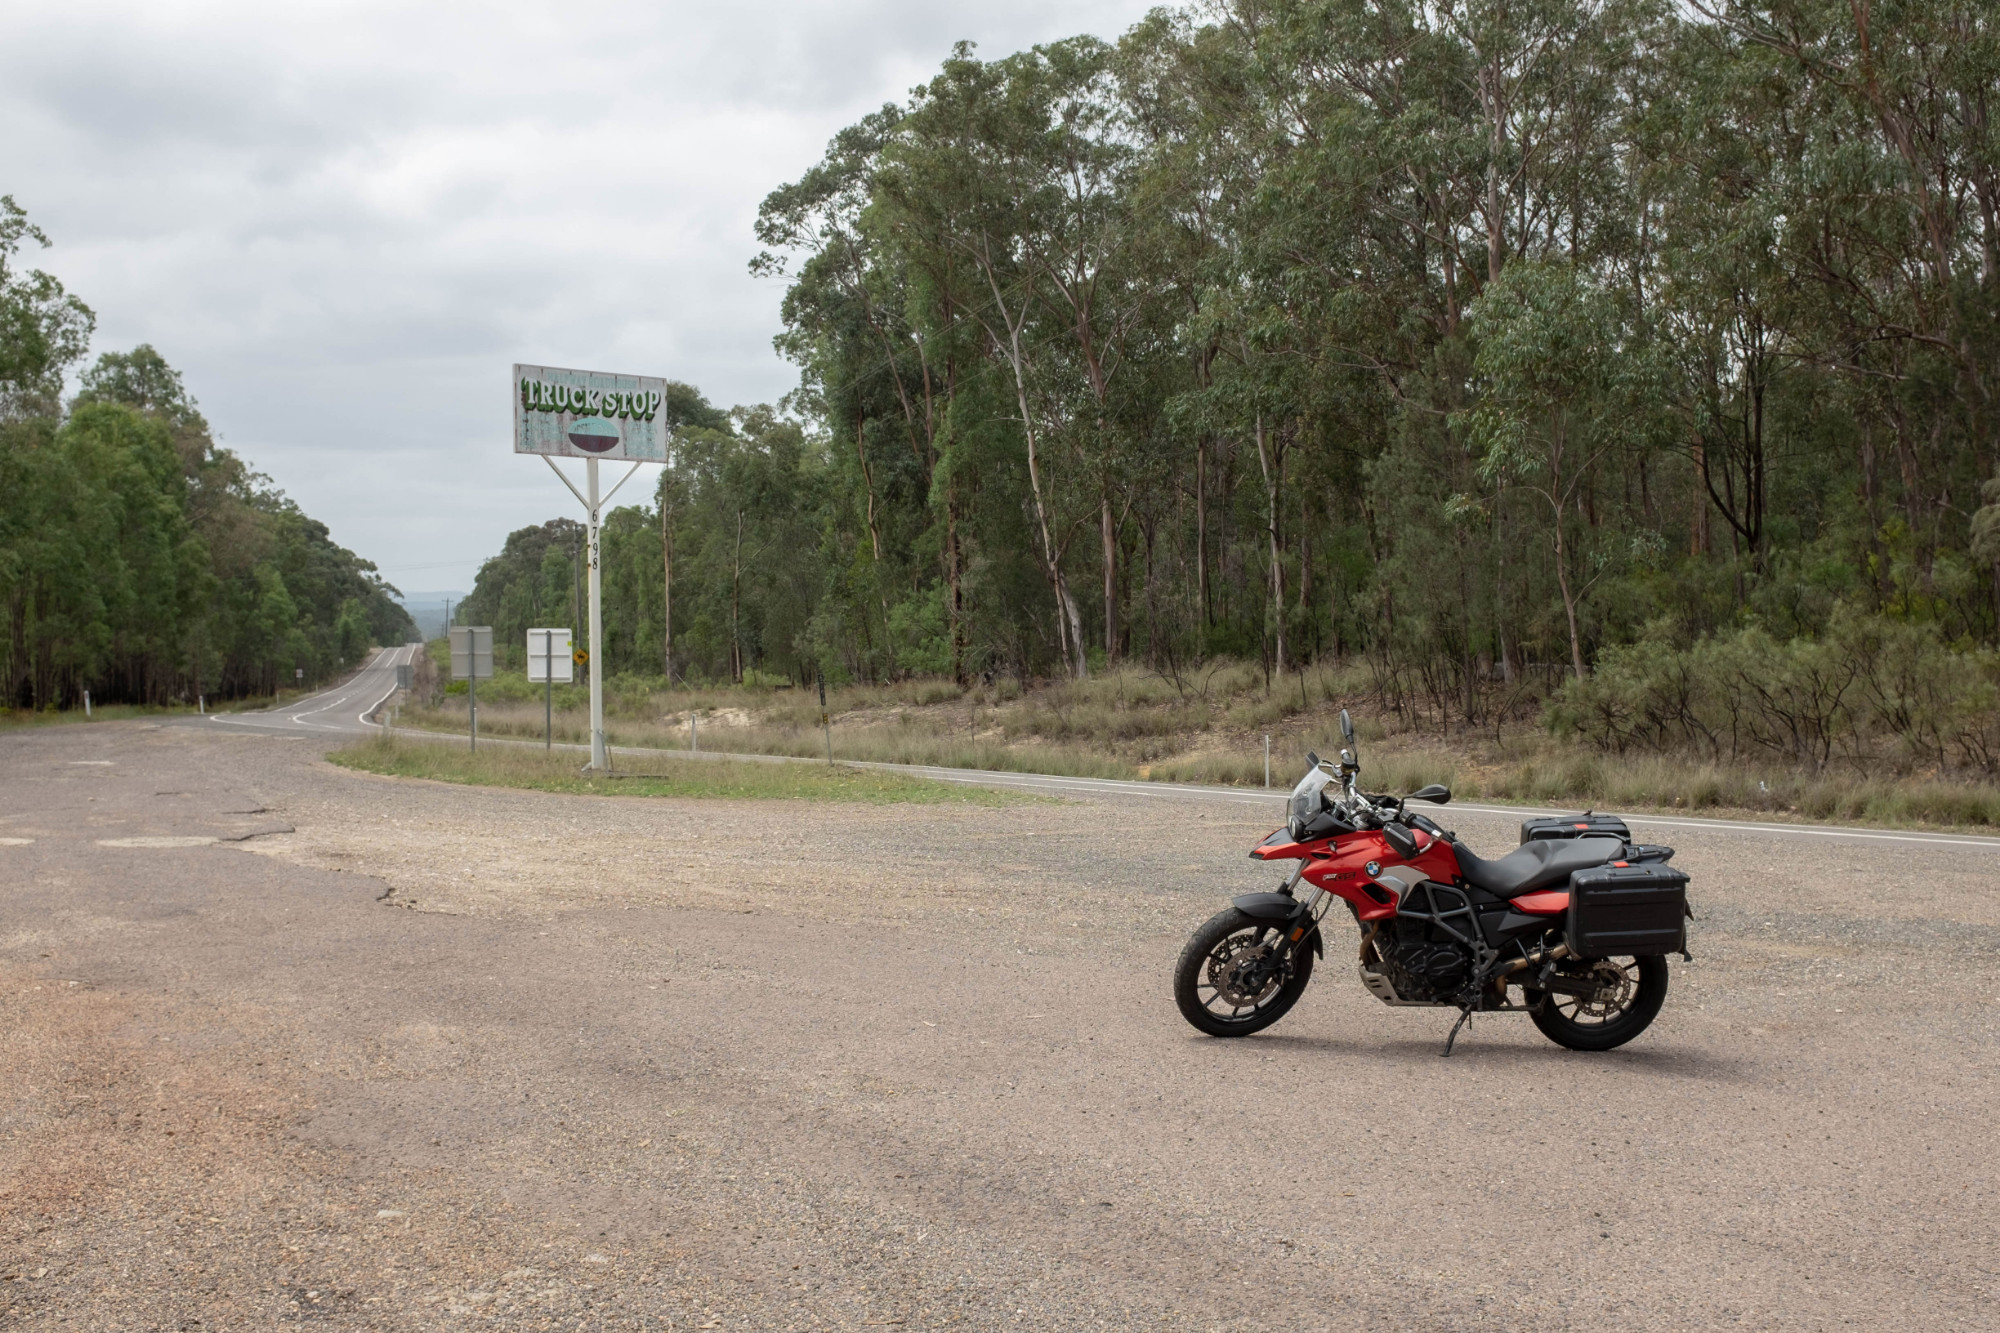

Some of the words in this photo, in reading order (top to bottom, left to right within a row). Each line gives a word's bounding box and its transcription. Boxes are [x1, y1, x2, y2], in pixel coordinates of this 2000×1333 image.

[521, 375, 600, 416] TRUCK
[602, 389, 661, 421] STOP
[591, 508, 599, 570] 6798
